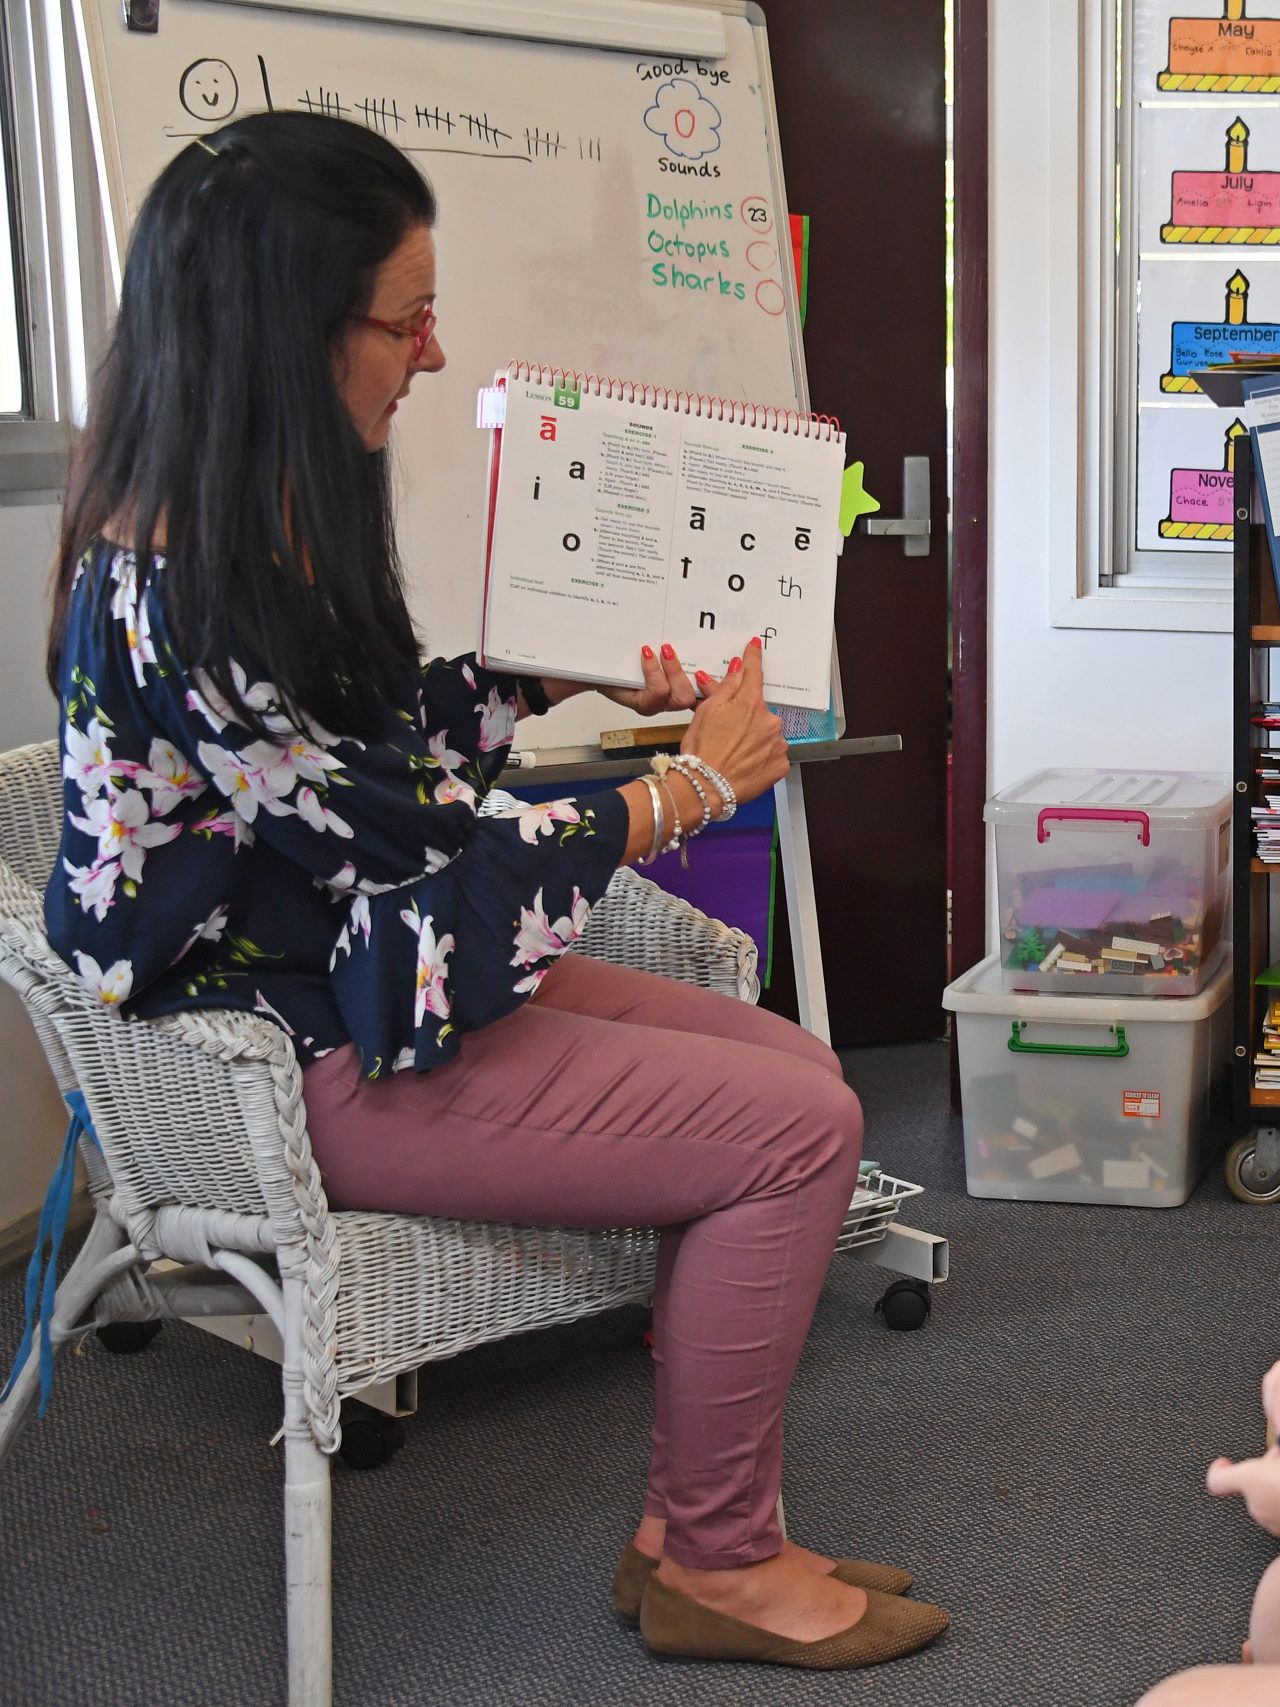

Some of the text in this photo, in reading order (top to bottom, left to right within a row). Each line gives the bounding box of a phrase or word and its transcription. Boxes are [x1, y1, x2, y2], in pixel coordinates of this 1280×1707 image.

[1218, 23, 1255, 39] May
[696, 62, 731, 86] bye
[1221, 176, 1254, 192] July
[646, 193, 768, 230] Dolphins 23
[647, 230, 730, 263] Octopus
[652, 263, 746, 300] Sharks
[1194, 326, 1280, 343] September
[558, 396, 575, 407] 59
[568, 460, 586, 481] a
[1198, 473, 1235, 488] Nove
[533, 476, 541, 500] i
[562, 533, 581, 552] o
[740, 532, 756, 552] c
[680, 556, 693, 579] t
[727, 573, 745, 592] o
[777, 574, 803, 600] th
[699, 610, 716, 630] n
[759, 627, 777, 650] f
